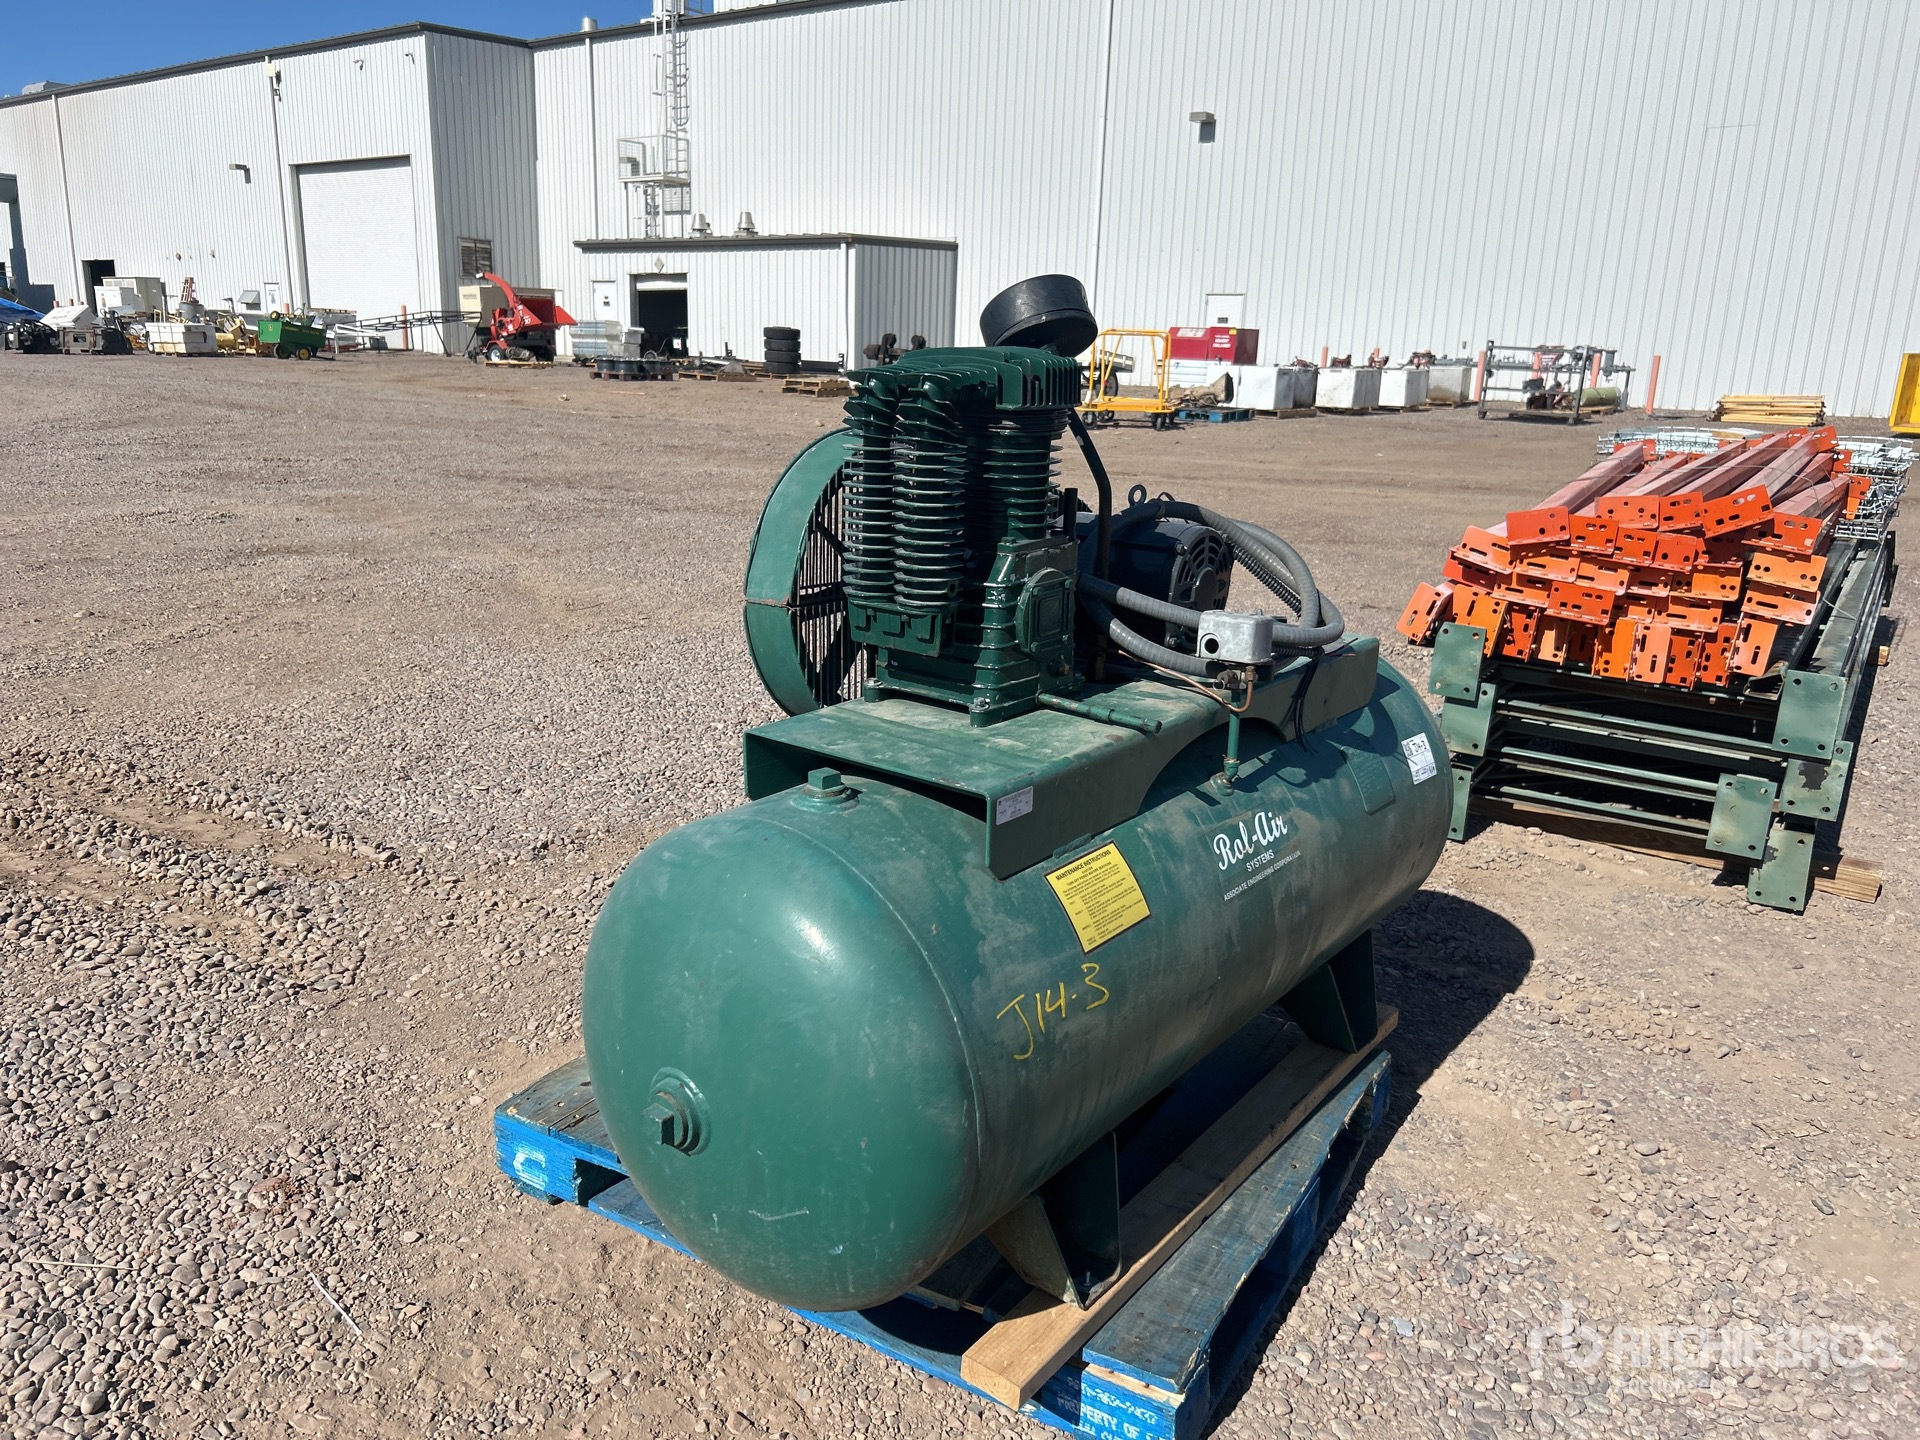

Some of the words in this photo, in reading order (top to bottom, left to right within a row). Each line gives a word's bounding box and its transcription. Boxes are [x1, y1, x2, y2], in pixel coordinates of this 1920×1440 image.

[1213, 811, 1288, 871] Rol-Air
[1246, 849, 1275, 872] SYSTEMS
[1055, 864, 1085, 881] MAINTENANCE
[1083, 849, 1112, 867] INSTRUCTIONS
[1224, 881, 1248, 902] ASSOCIATE
[1247, 865, 1275, 887] ENGINEERING
[1273, 850, 1301, 871] CORPORATION
[1057, 1396, 1118, 1431] PROPERTY
[1123, 1422, 1140, 1440] OF
